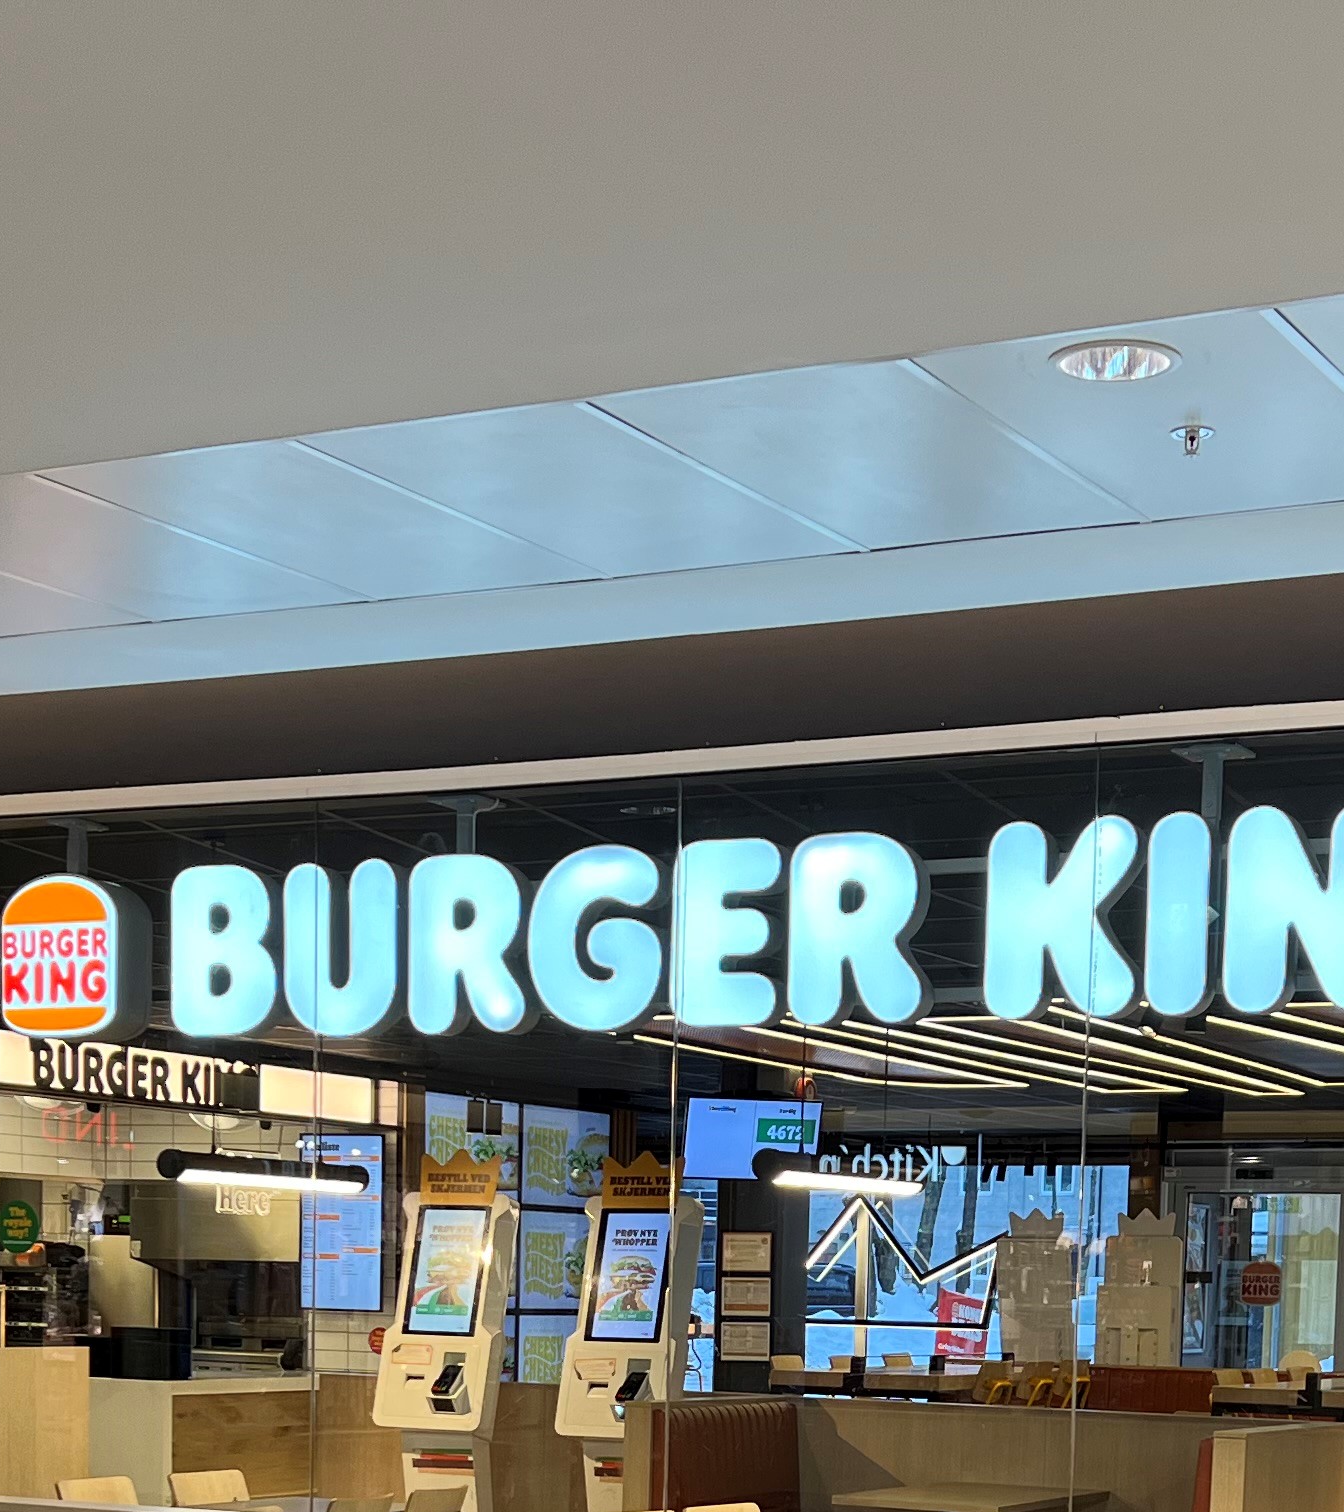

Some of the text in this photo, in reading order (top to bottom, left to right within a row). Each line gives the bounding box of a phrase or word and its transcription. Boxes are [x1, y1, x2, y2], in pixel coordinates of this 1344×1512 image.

[169, 830, 926, 1038] BURGER
[2, 927, 108, 960] BURGER
[3, 959, 107, 1005] KING
[33, 1042, 171, 1101] BURGER
[766, 1125, 804, 1140] 4672
[428, 1173, 490, 1184] BESTILL VED
[610, 1176, 652, 1186] BESTILL
[430, 1184, 486, 1193] SKJERMEN
[216, 1185, 270, 1216] Here
[1242, 1275, 1281, 1284] BURGER
[1241, 1284, 1281, 1297] KING
